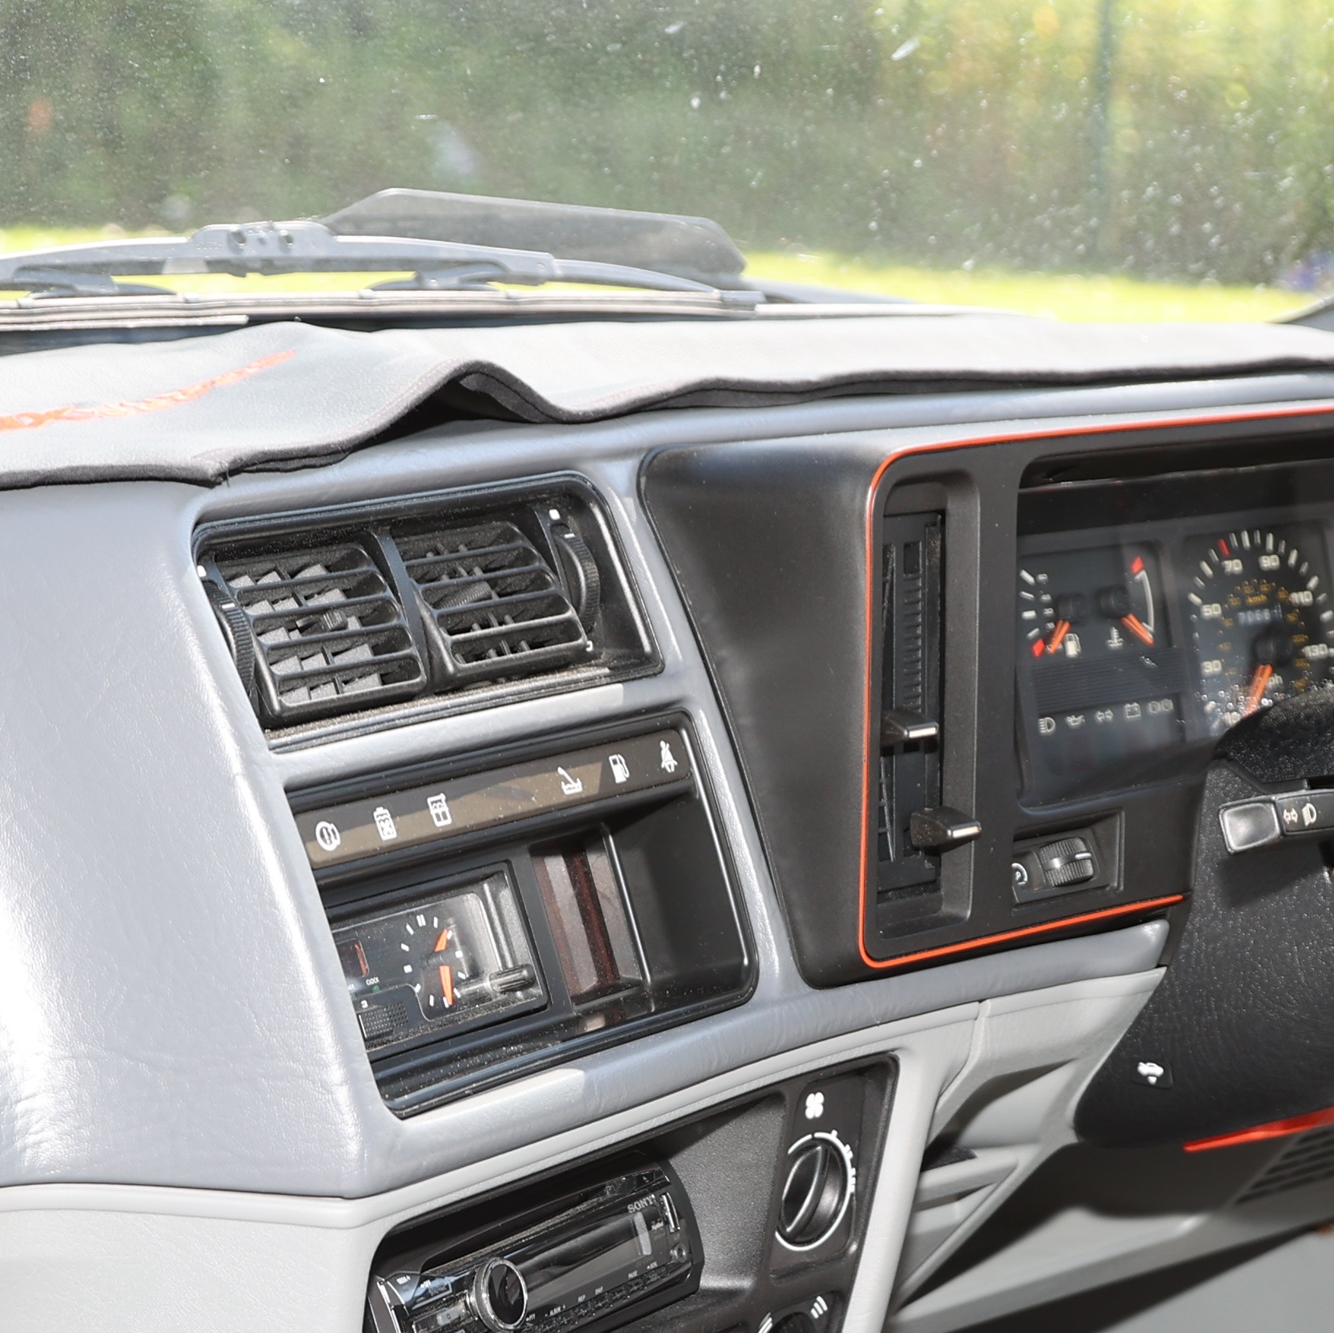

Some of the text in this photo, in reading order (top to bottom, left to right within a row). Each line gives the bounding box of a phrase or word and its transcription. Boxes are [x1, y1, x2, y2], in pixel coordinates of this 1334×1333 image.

[1222, 559, 1243, 573] 70
[1259, 554, 1280, 569] 90
[1289, 590, 1313, 605] 110
[1201, 603, 1222, 618] 50
[1304, 643, 1328, 658] 130
[1201, 659, 1222, 675] 30
[361, 1000, 368, 1008] 3
[627, 1194, 654, 1214] SONY
